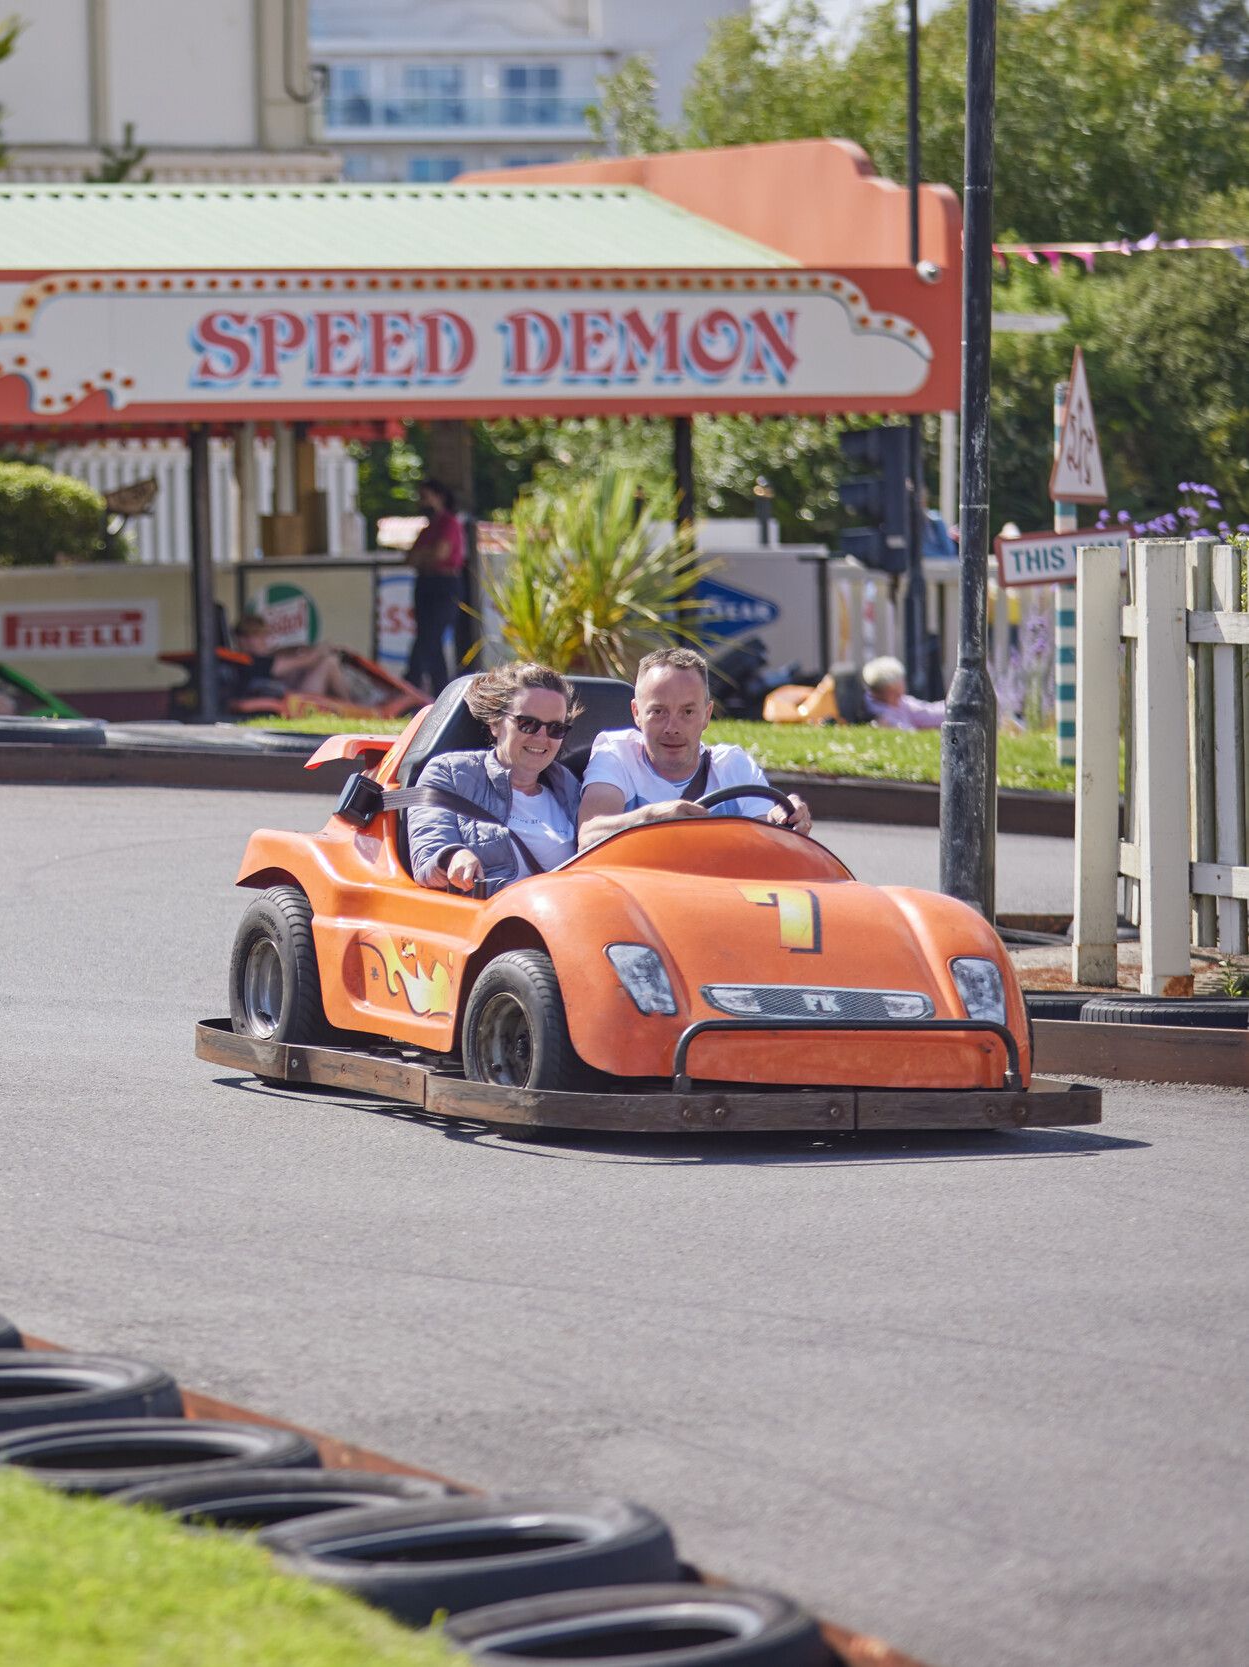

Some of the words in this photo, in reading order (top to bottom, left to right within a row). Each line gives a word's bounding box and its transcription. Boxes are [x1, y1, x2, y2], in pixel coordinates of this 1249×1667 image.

[188, 309, 477, 389] SPEED
[495, 308, 799, 387] DEMON
[1010, 543, 1066, 575] THIS
[3, 609, 142, 648] PIRELLI
